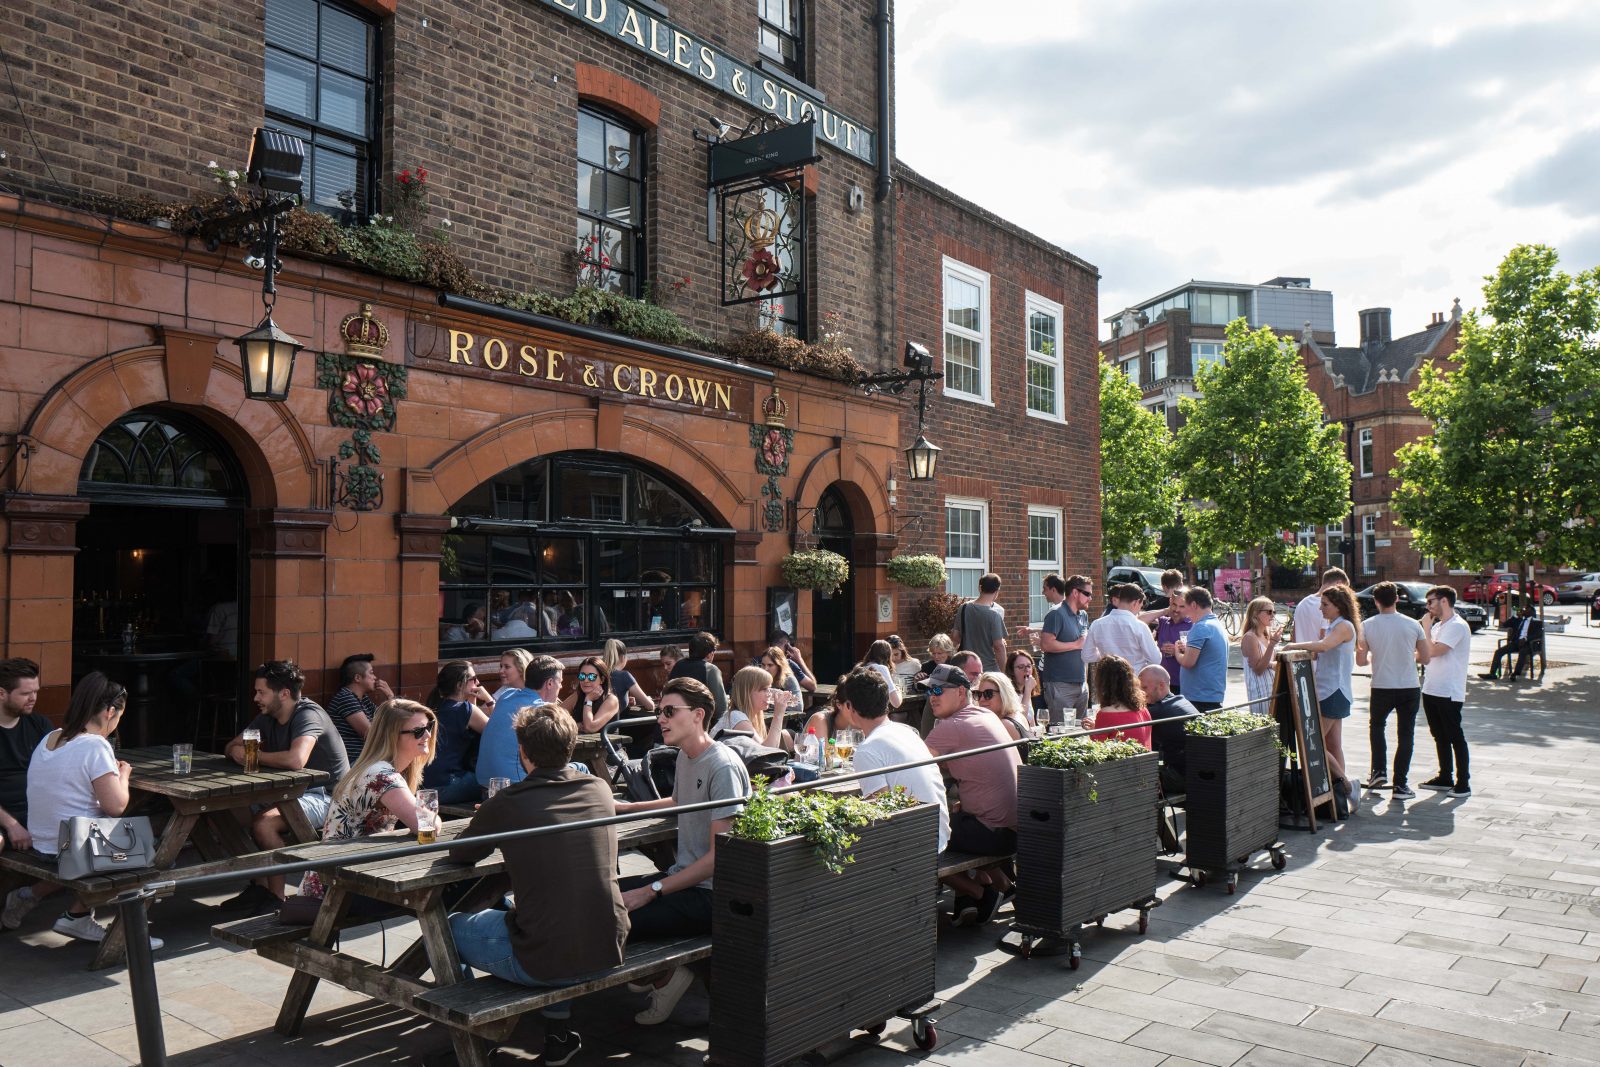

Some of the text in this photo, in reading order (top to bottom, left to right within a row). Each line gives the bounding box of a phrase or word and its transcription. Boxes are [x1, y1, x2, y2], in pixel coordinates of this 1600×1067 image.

[618, 5, 717, 80] ALES
[731, 68, 748, 98] &
[762, 79, 857, 151] STOUT
[448, 329, 732, 411] ROSE & CROWN
